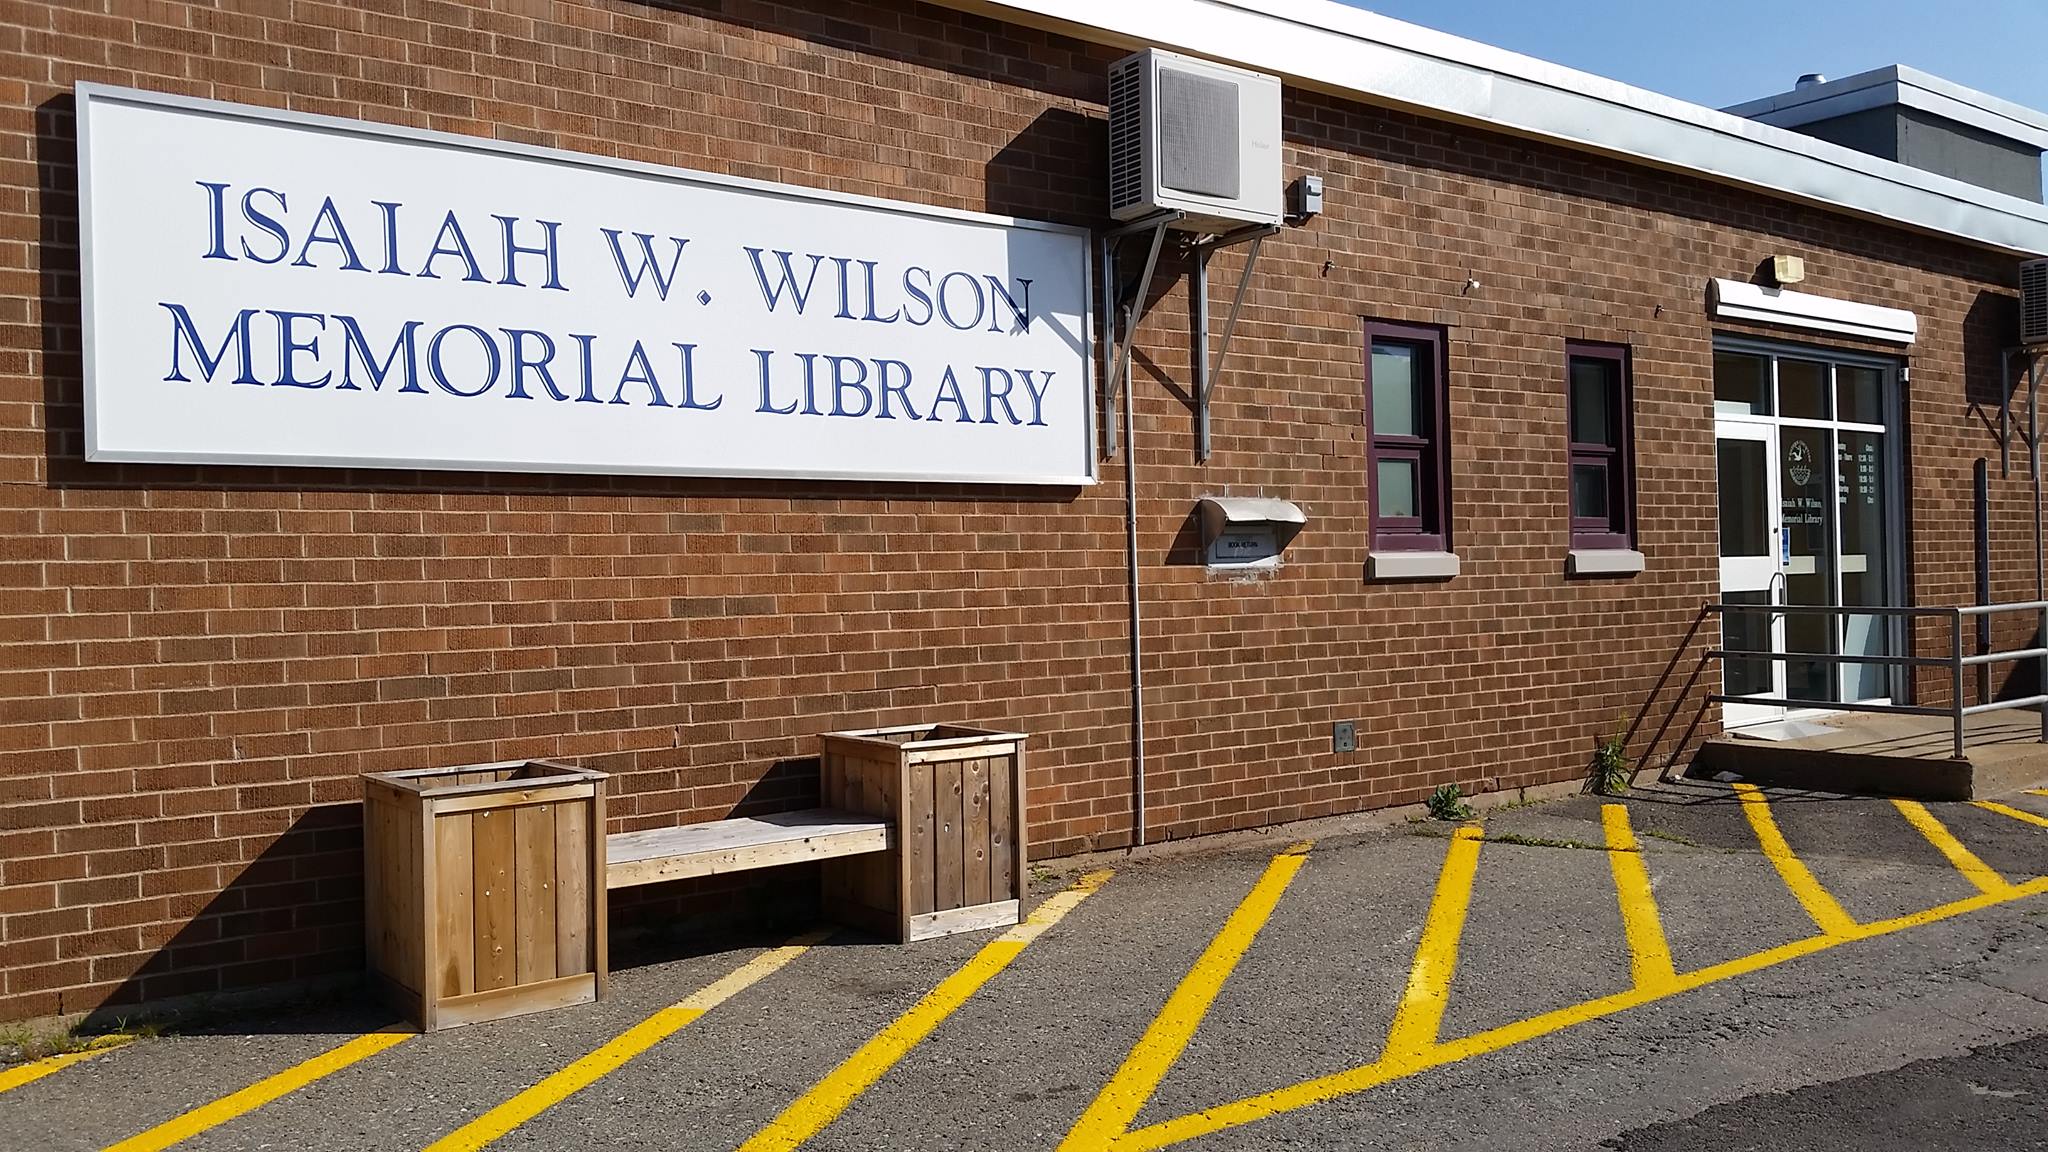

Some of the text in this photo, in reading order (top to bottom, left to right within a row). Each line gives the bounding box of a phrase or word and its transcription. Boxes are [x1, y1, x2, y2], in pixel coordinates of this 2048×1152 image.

[195, 180, 1033, 335] ISAIAH W. WILSON
[157, 302, 1056, 427] MEMORIAL LIBRARY
[1804, 513, 1823, 526] Library
